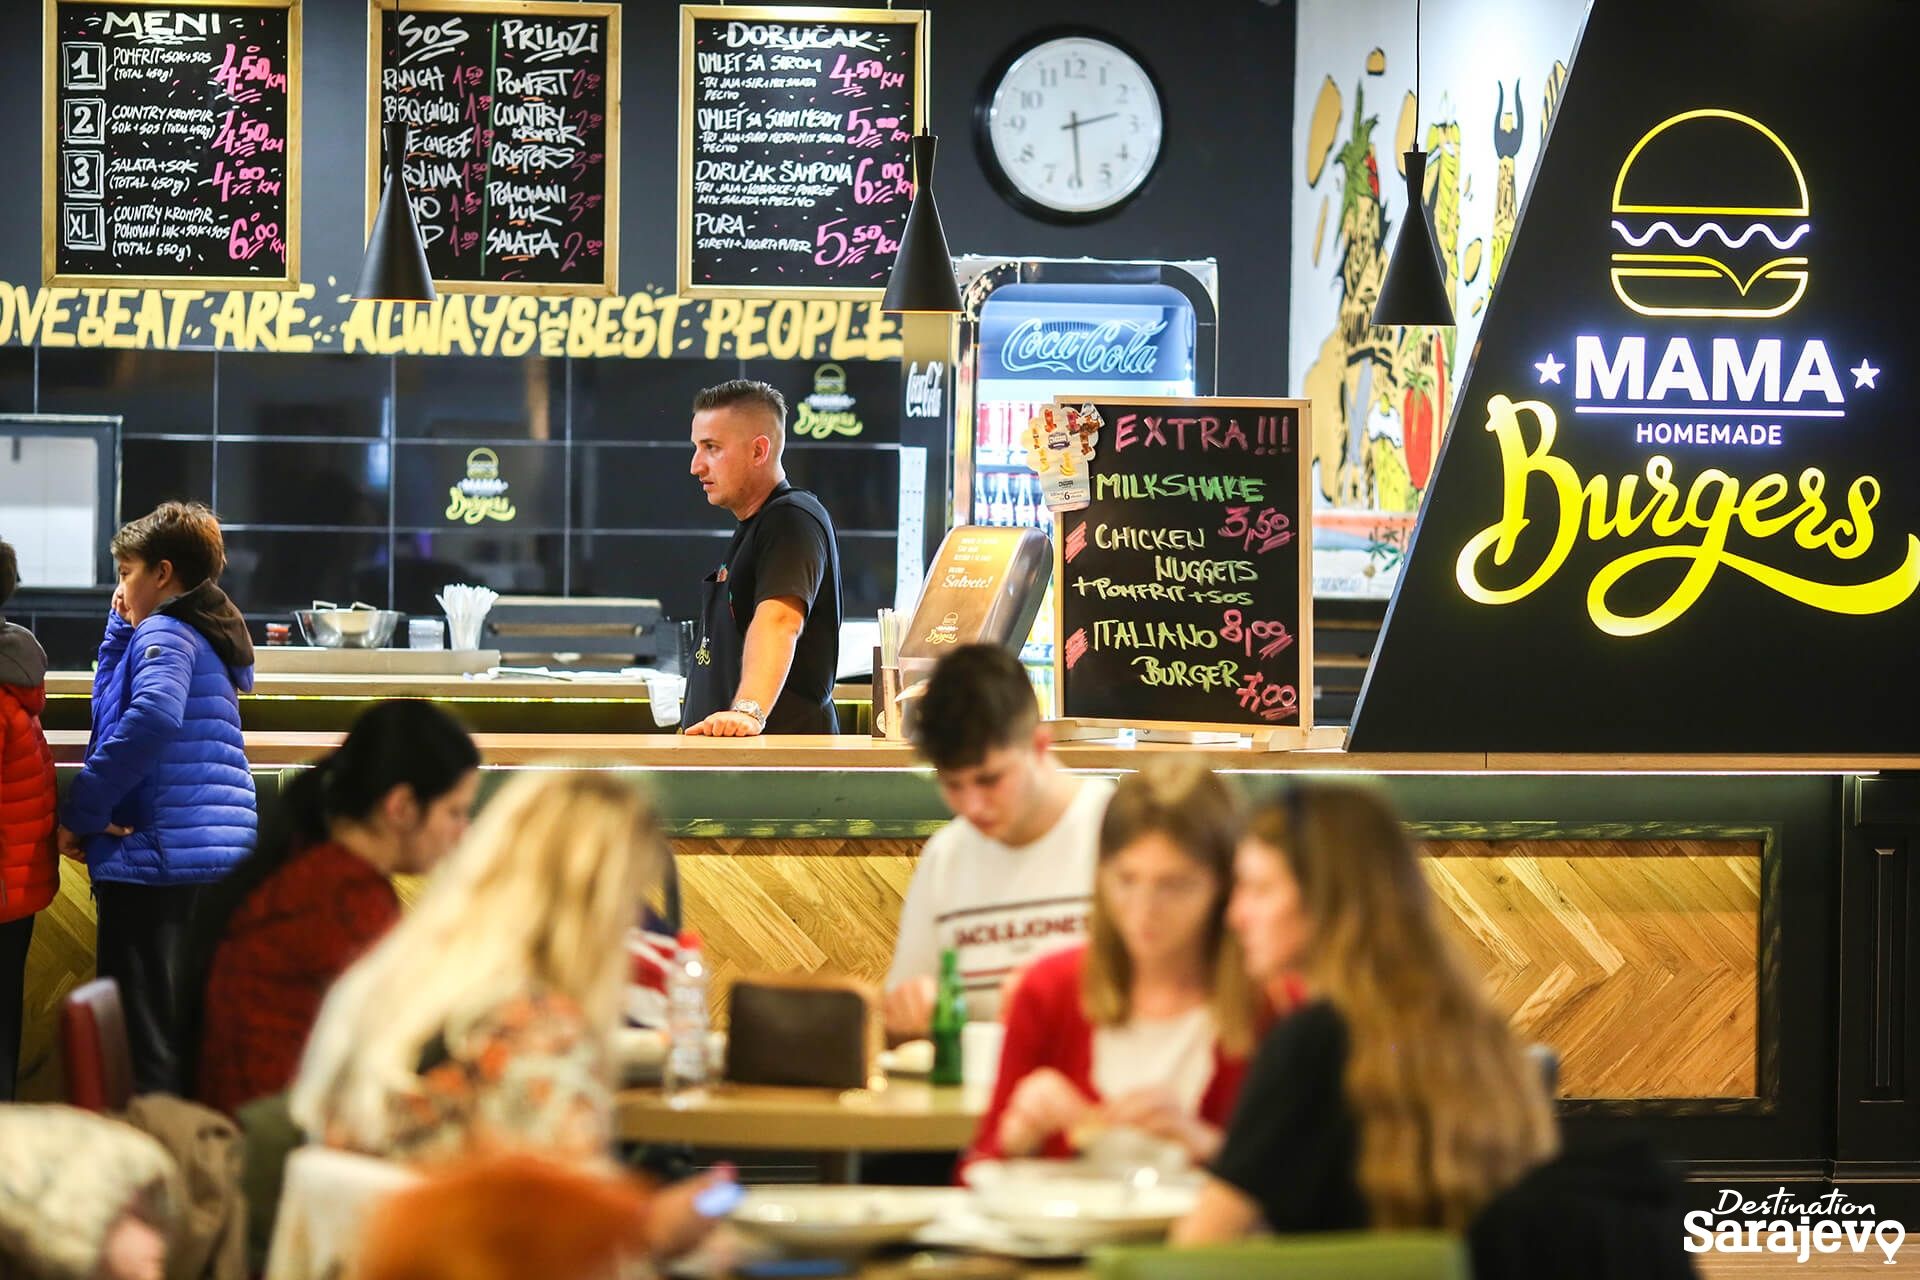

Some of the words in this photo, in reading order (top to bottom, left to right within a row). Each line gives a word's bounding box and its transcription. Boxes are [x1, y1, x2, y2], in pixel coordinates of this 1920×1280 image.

[102, 11, 221, 36] MENI
[398, 15, 470, 47] SOS
[727, 22, 880, 51] DORUČAK
[72, 51, 96, 78] 1
[698, 52, 745, 75] OMLET
[745, 54, 766, 72] SA
[1064, 59, 1086, 79] 12
[265, 73, 286, 93] KM
[880, 71, 904, 90] KM
[1040, 67, 1057, 87] 11
[1100, 66, 1106, 86] 1
[704, 89, 740, 101] PECIVO
[1021, 91, 1043, 109] 10
[1117, 84, 1128, 104] 2
[74, 106, 94, 135] 2
[111, 104, 167, 120] COUNTRY
[166, 107, 214, 123] KROMPIR
[494, 102, 565, 128] COUNTRY
[698, 107, 749, 131] OMLET
[746, 112, 762, 129] SA
[1010, 115, 1025, 133] 9
[1128, 116, 1140, 133] 3
[261, 138, 284, 153] KM
[1021, 144, 1035, 163] 8
[1115, 144, 1128, 160] 4
[72, 157, 89, 187] 3
[696, 160, 776, 183] DORUČAK
[1044, 164, 1056, 183] 7
[1099, 163, 1111, 187] 5
[256, 179, 281, 196] KM
[69, 214, 93, 238] XL
[114, 204, 162, 224] COUNTRY
[164, 206, 214, 224] KROMPIR
[509, 203, 563, 227] LUK
[486, 227, 559, 258] SALATA
[104, 288, 206, 349] EAT
[210, 284, 315, 353] ARE
[340, 294, 539, 357] ALWAYS
[566, 291, 693, 359] BEST
[702, 299, 903, 361] PEOPLE
[1001, 318, 1168, 374] Coca-Cola
[1575, 336, 1845, 403] MAMA
[1636, 423, 1782, 446] HOMEMADE
[1096, 473, 1265, 502] MILKSHAKE
[1456, 394, 1920, 637] Burgers
[1094, 523, 1206, 550] CHICKEN
[1155, 555, 1259, 586] NUGGETS
[1093, 620, 1219, 651] ITALIANO
[1131, 656, 1240, 693] BURGER
